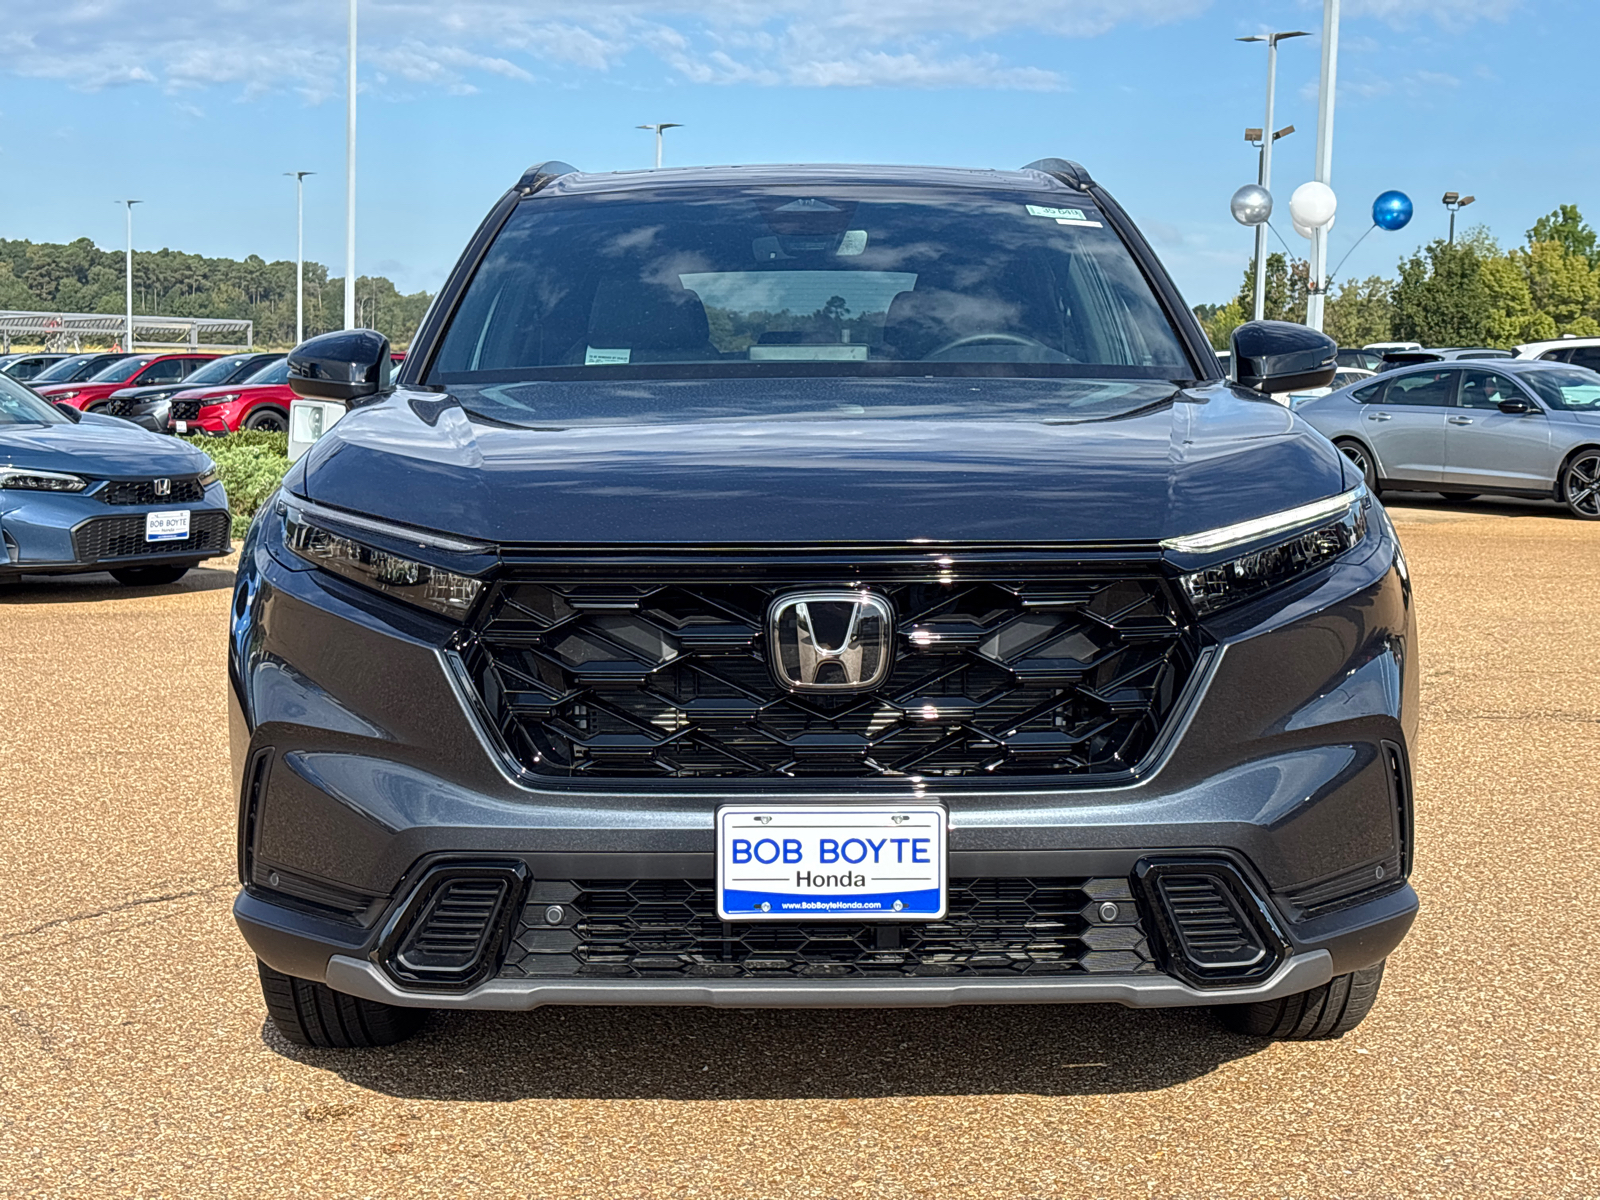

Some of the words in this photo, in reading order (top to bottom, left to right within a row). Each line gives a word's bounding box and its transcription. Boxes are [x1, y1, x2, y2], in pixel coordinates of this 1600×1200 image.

[149, 519, 164, 528] BOB
[166, 518, 187, 527] BOYTE
[732, 838, 803, 864] BOB
[819, 838, 931, 864] BOYTE
[796, 870, 866, 888] Honda
[781, 901, 882, 911] www.BobBoyteHonda.com
